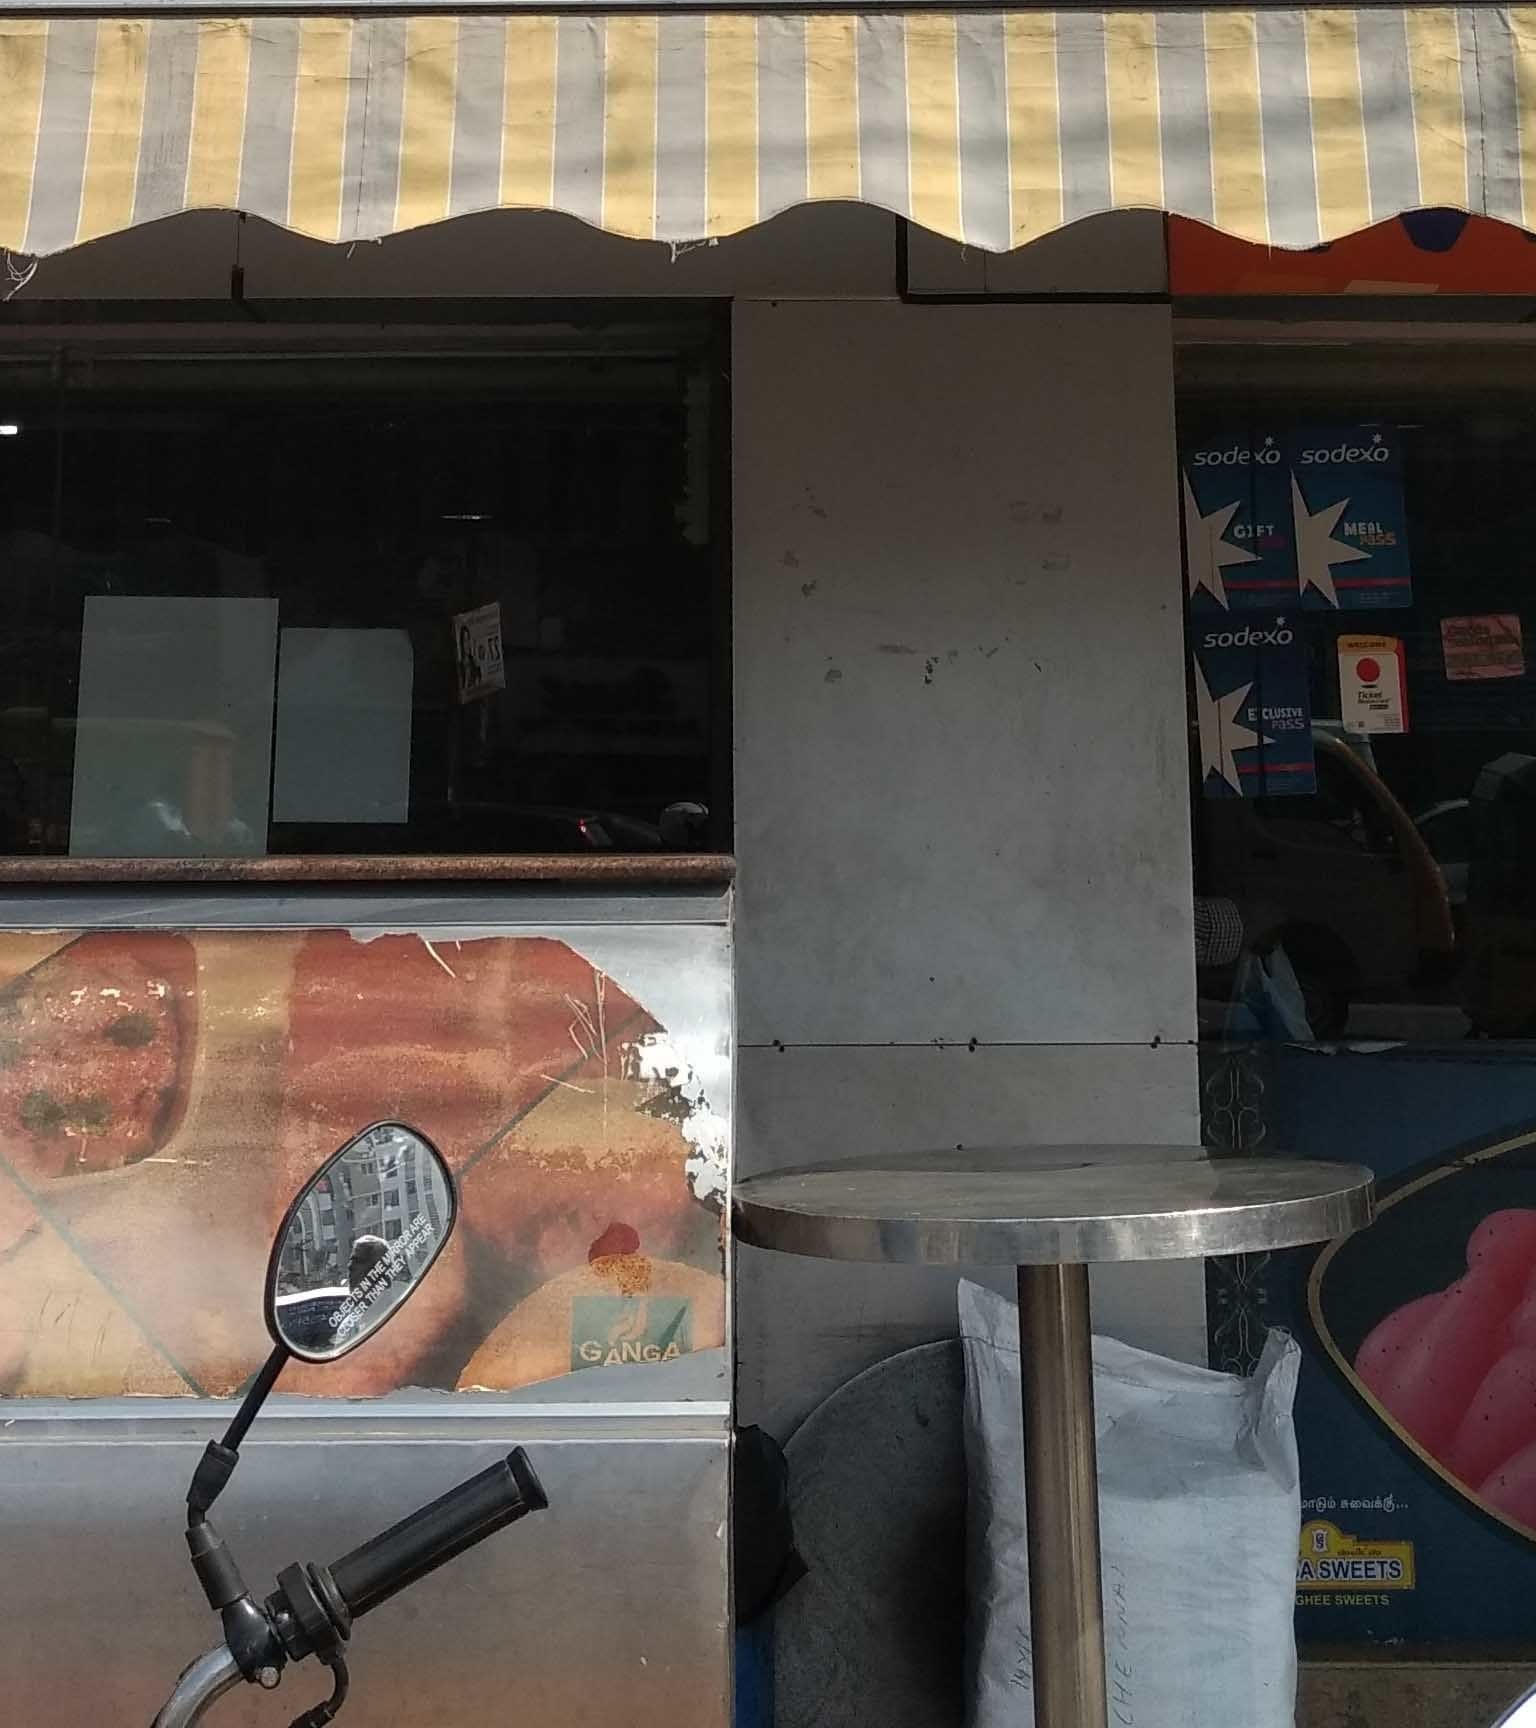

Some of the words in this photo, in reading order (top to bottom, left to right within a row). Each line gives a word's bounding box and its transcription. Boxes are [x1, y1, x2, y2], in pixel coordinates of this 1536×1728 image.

[1193, 445, 1281, 466] sodexo
[1301, 443, 1390, 464] sodexo
[1233, 522, 1275, 539] GIFT
[1344, 521, 1384, 537] MEAL
[1203, 626, 1294, 648] sodexo
[1248, 706, 1305, 722] ECLUSIVE
[328, 1288, 364, 1328] OBJECTS
[359, 1278, 372, 1291] IN
[368, 1261, 386, 1281] THE
[382, 1231, 413, 1264] MIRROR
[408, 1213, 426, 1233] ARE
[365, 1278, 389, 1303] THAN
[385, 1256, 407, 1279] THEY
[403, 1223, 435, 1257] APPEAR
[579, 1341, 681, 1367] GANGA
[1319, 1560, 1402, 1580] SWEETS
[1295, 1594, 1331, 1606] GHEE
[1335, 1594, 1390, 1606] SWEETS
